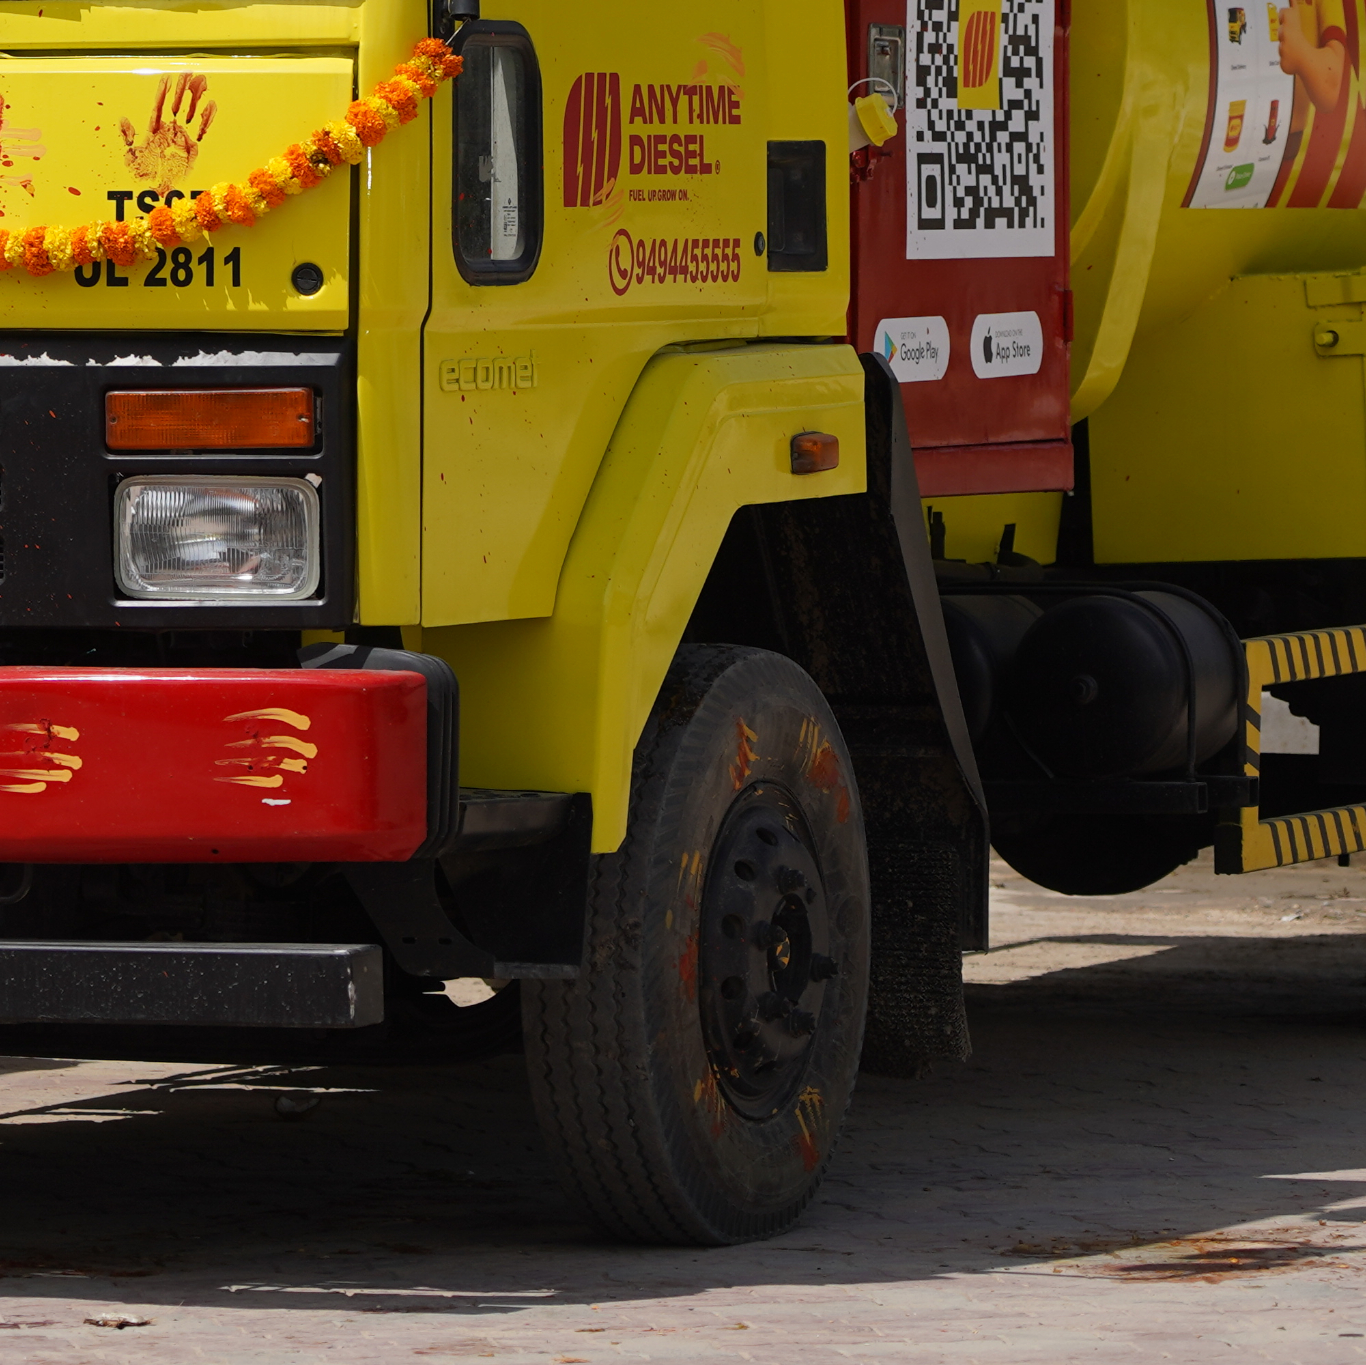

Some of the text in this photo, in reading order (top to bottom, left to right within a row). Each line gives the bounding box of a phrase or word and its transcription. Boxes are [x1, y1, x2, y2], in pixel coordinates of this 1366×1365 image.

[629, 84, 741, 125] ANYTIME
[629, 134, 713, 175] DIESEL
[629, 189, 645, 201] FUEL
[144, 246, 241, 287] 2811
[635, 238, 741, 284] 9494455555
[900, 341, 938, 364] Google Play
[996, 341, 1031, 363] App Store
